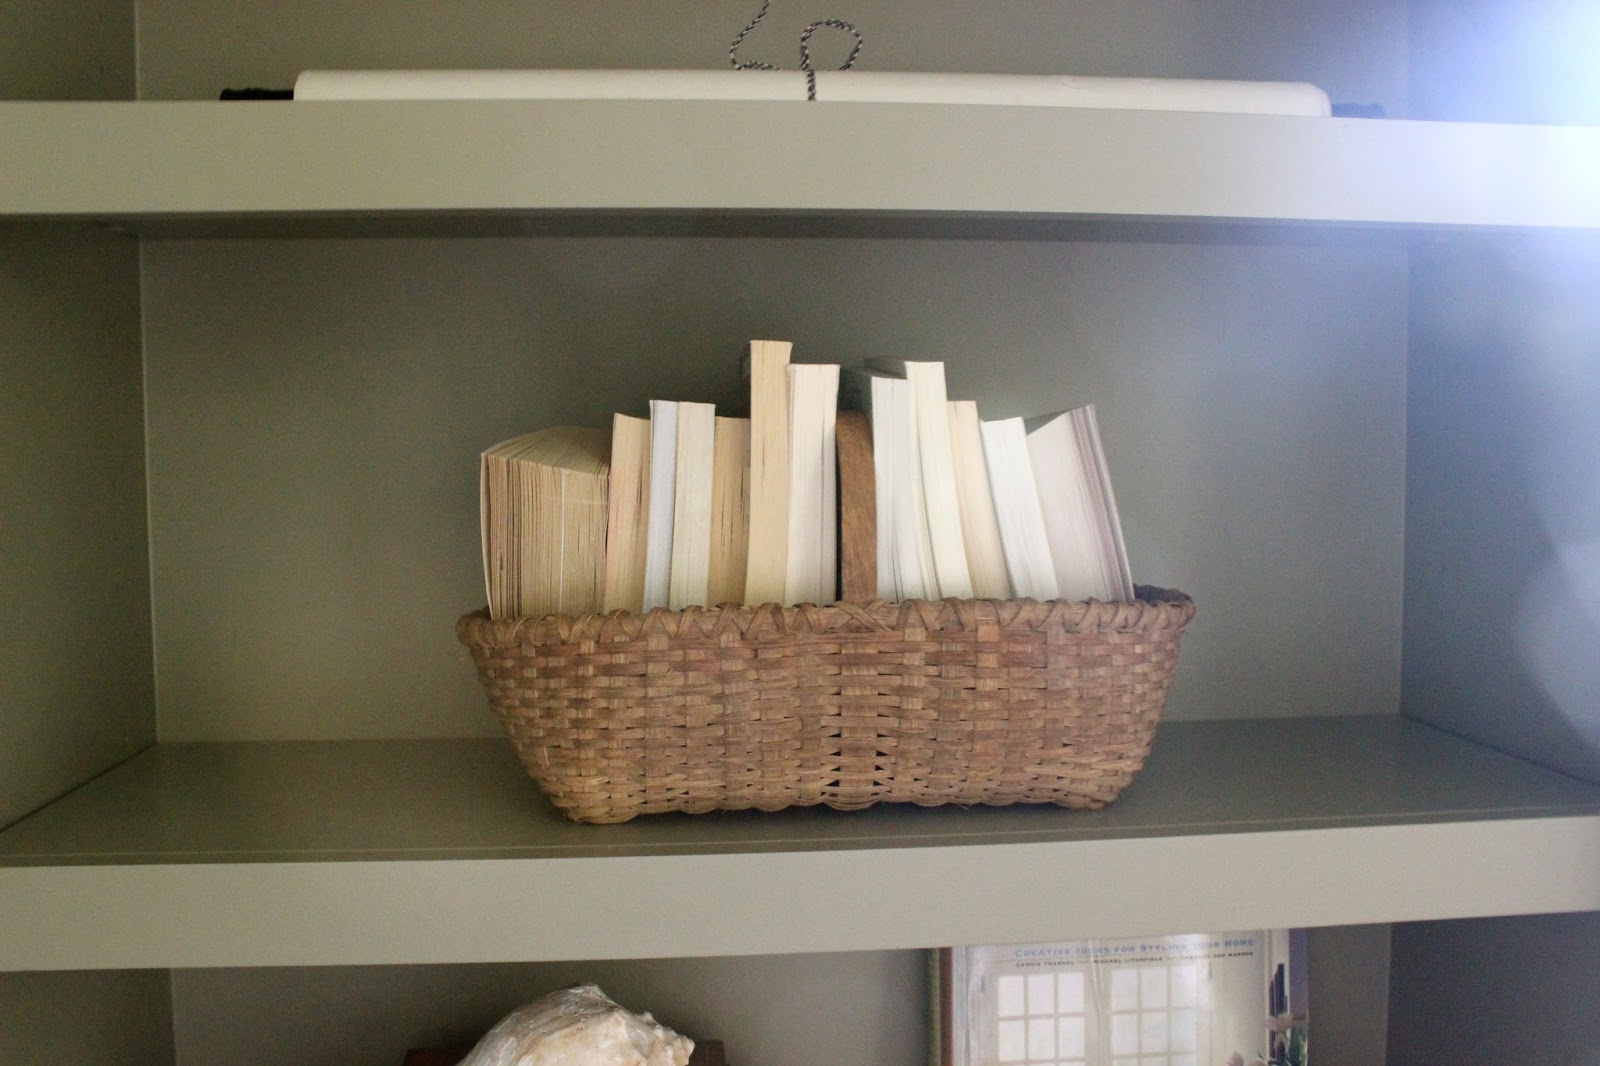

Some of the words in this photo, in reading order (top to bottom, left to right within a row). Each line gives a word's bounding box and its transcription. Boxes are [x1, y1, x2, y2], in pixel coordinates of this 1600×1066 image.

[1015, 948, 1071, 957] CREATIVE
[1114, 945, 1136, 953] FOR
[1140, 943, 1187, 952] STYLING
[1225, 938, 1254, 947] HOME
